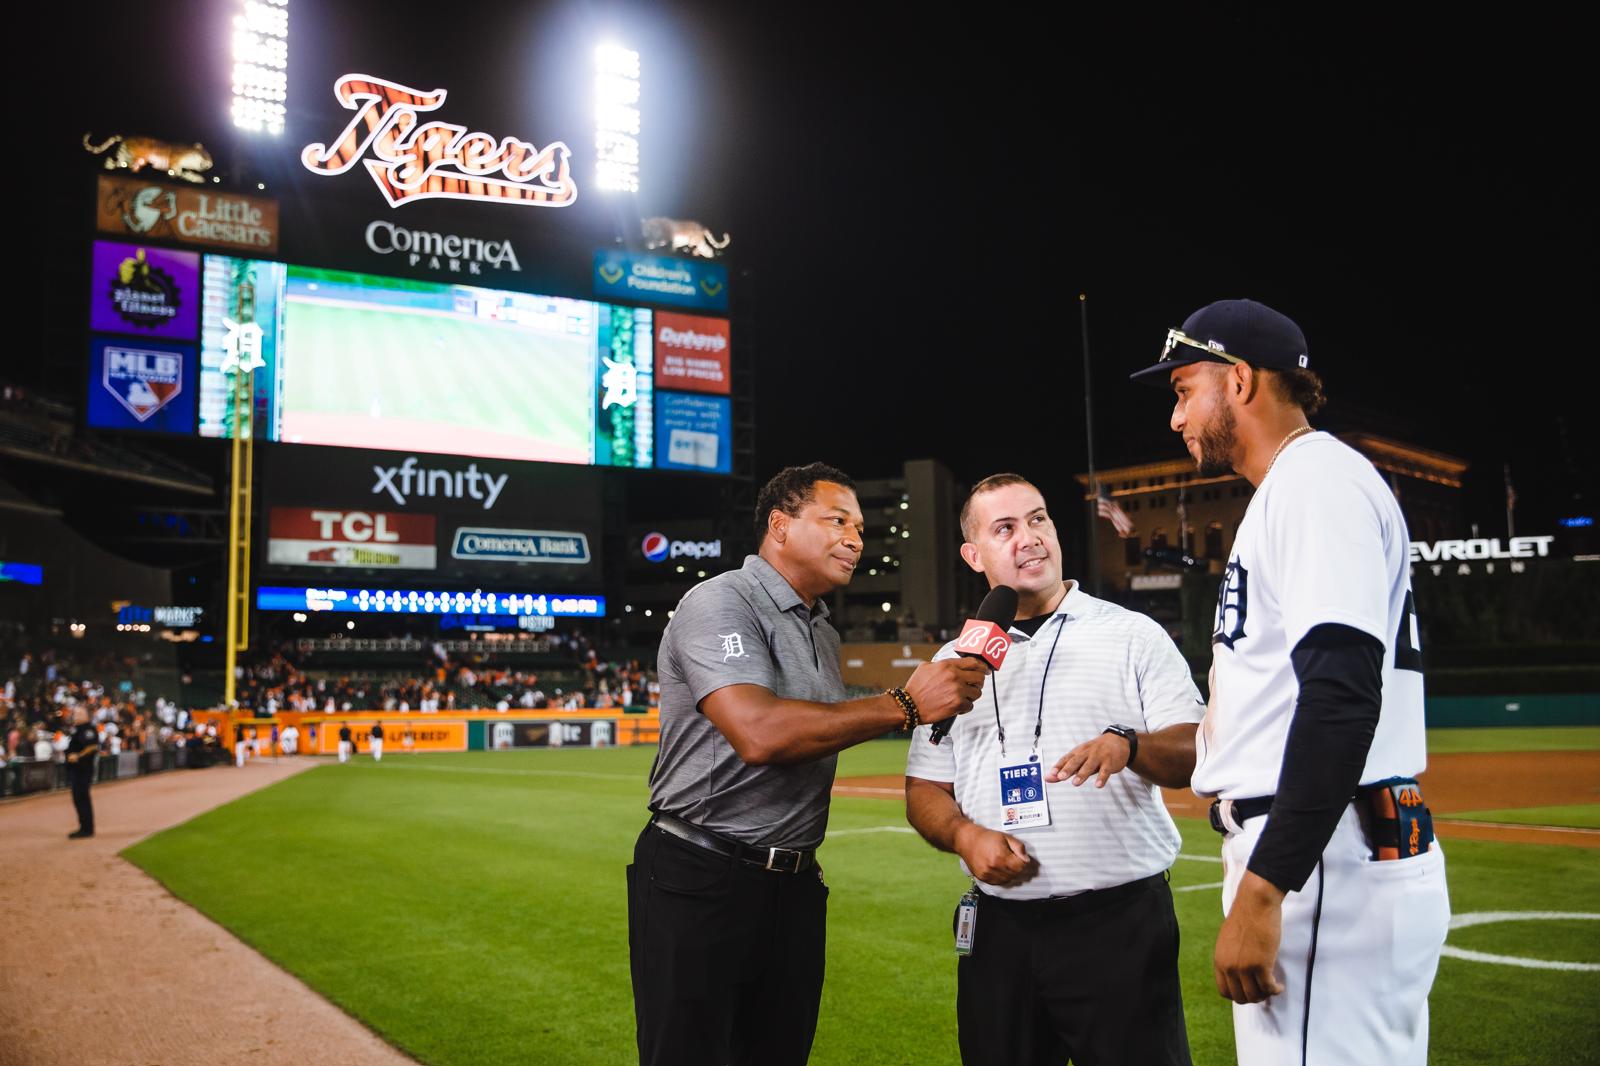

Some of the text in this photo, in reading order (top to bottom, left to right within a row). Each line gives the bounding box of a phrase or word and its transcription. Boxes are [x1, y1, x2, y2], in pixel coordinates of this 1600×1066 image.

[301, 73, 578, 208] Tigers
[199, 195, 263, 226] Little
[177, 211, 272, 247] Caesars
[409, 255, 481, 275] PARK
[627, 275, 697, 296] Foundation
[110, 351, 178, 376] MLB
[662, 365, 686, 378] LOW
[371, 457, 509, 509] xfinity
[311, 511, 400, 543] TCL
[539, 537, 580, 555] Bank
[670, 539, 722, 560] pepsi
[1409, 535, 1555, 563] EVROLET
[1410, 561, 1526, 577] TAIN
[1002, 766, 1038, 780] TIER 2
